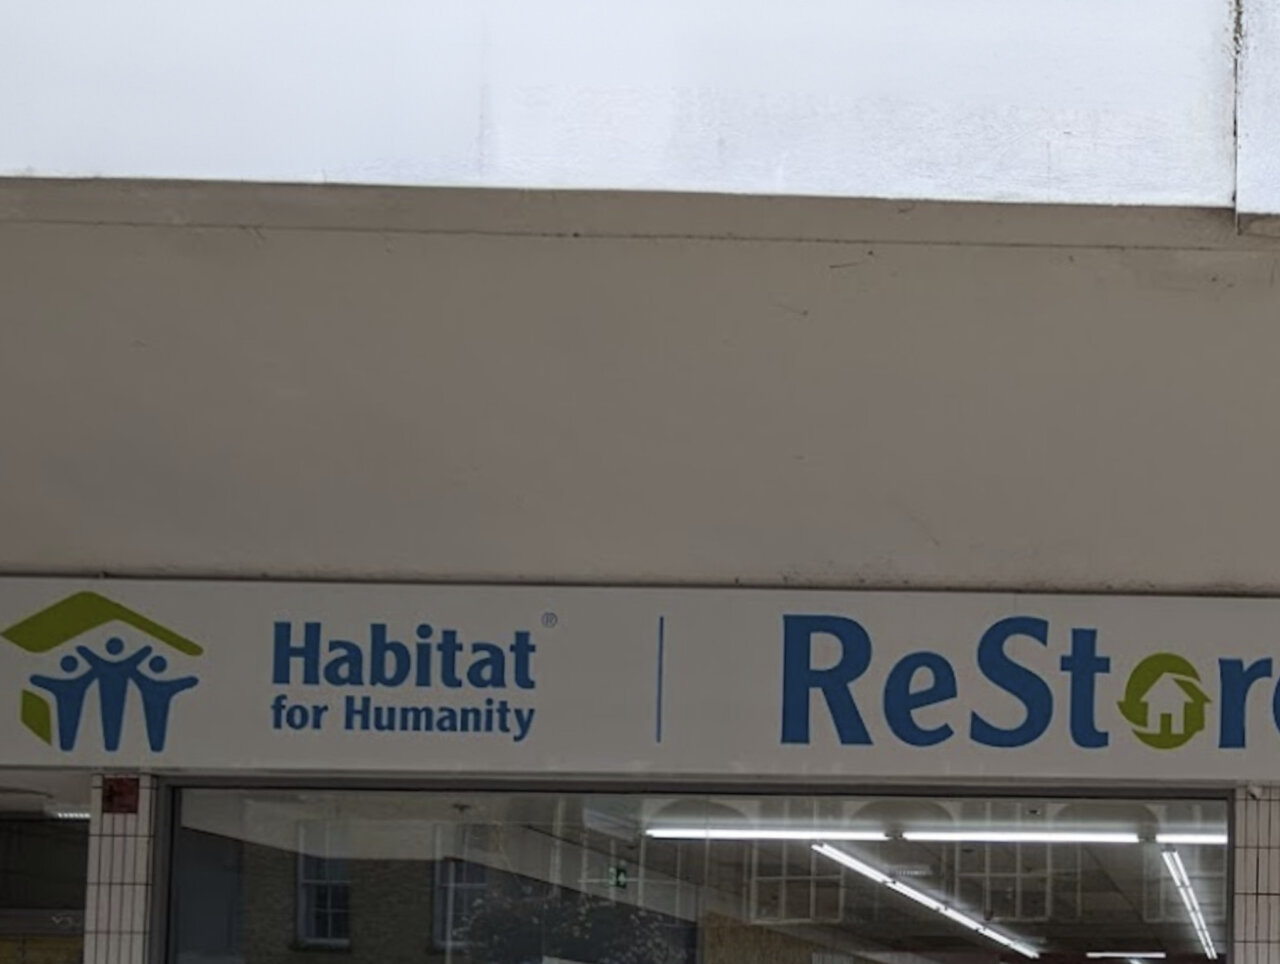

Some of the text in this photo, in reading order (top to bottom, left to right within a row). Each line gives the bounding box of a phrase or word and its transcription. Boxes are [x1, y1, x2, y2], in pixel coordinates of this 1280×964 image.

[272, 620, 537, 690] Habitat
[270, 695, 535, 742] for Humanity
